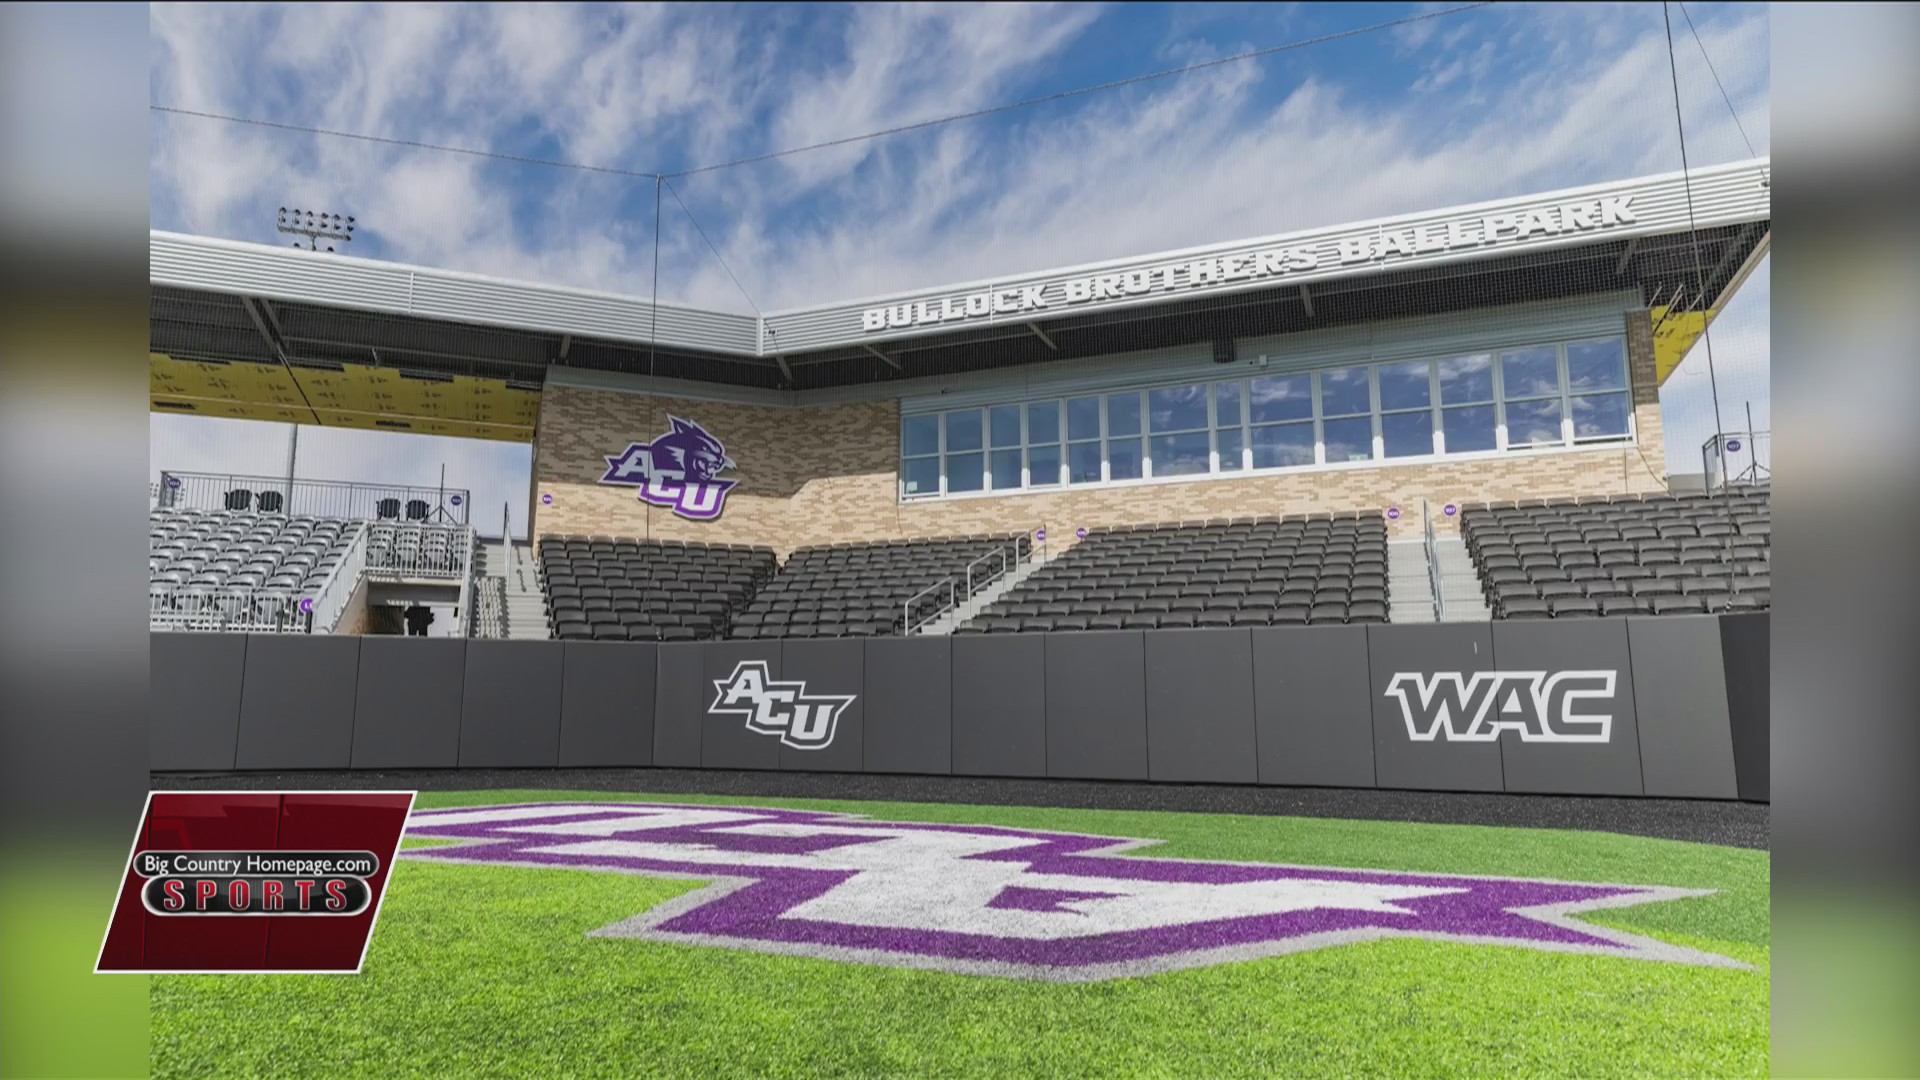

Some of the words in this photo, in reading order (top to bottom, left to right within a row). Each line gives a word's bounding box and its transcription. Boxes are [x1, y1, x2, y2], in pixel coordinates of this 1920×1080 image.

[862, 284, 1048, 332] BULLOCK
[1064, 246, 1318, 304] BROTHERS
[1337, 196, 1636, 265] BALLPARK
[614, 450, 722, 511] ACU
[723, 670, 835, 740] ACU
[1384, 670, 1617, 743] WAC
